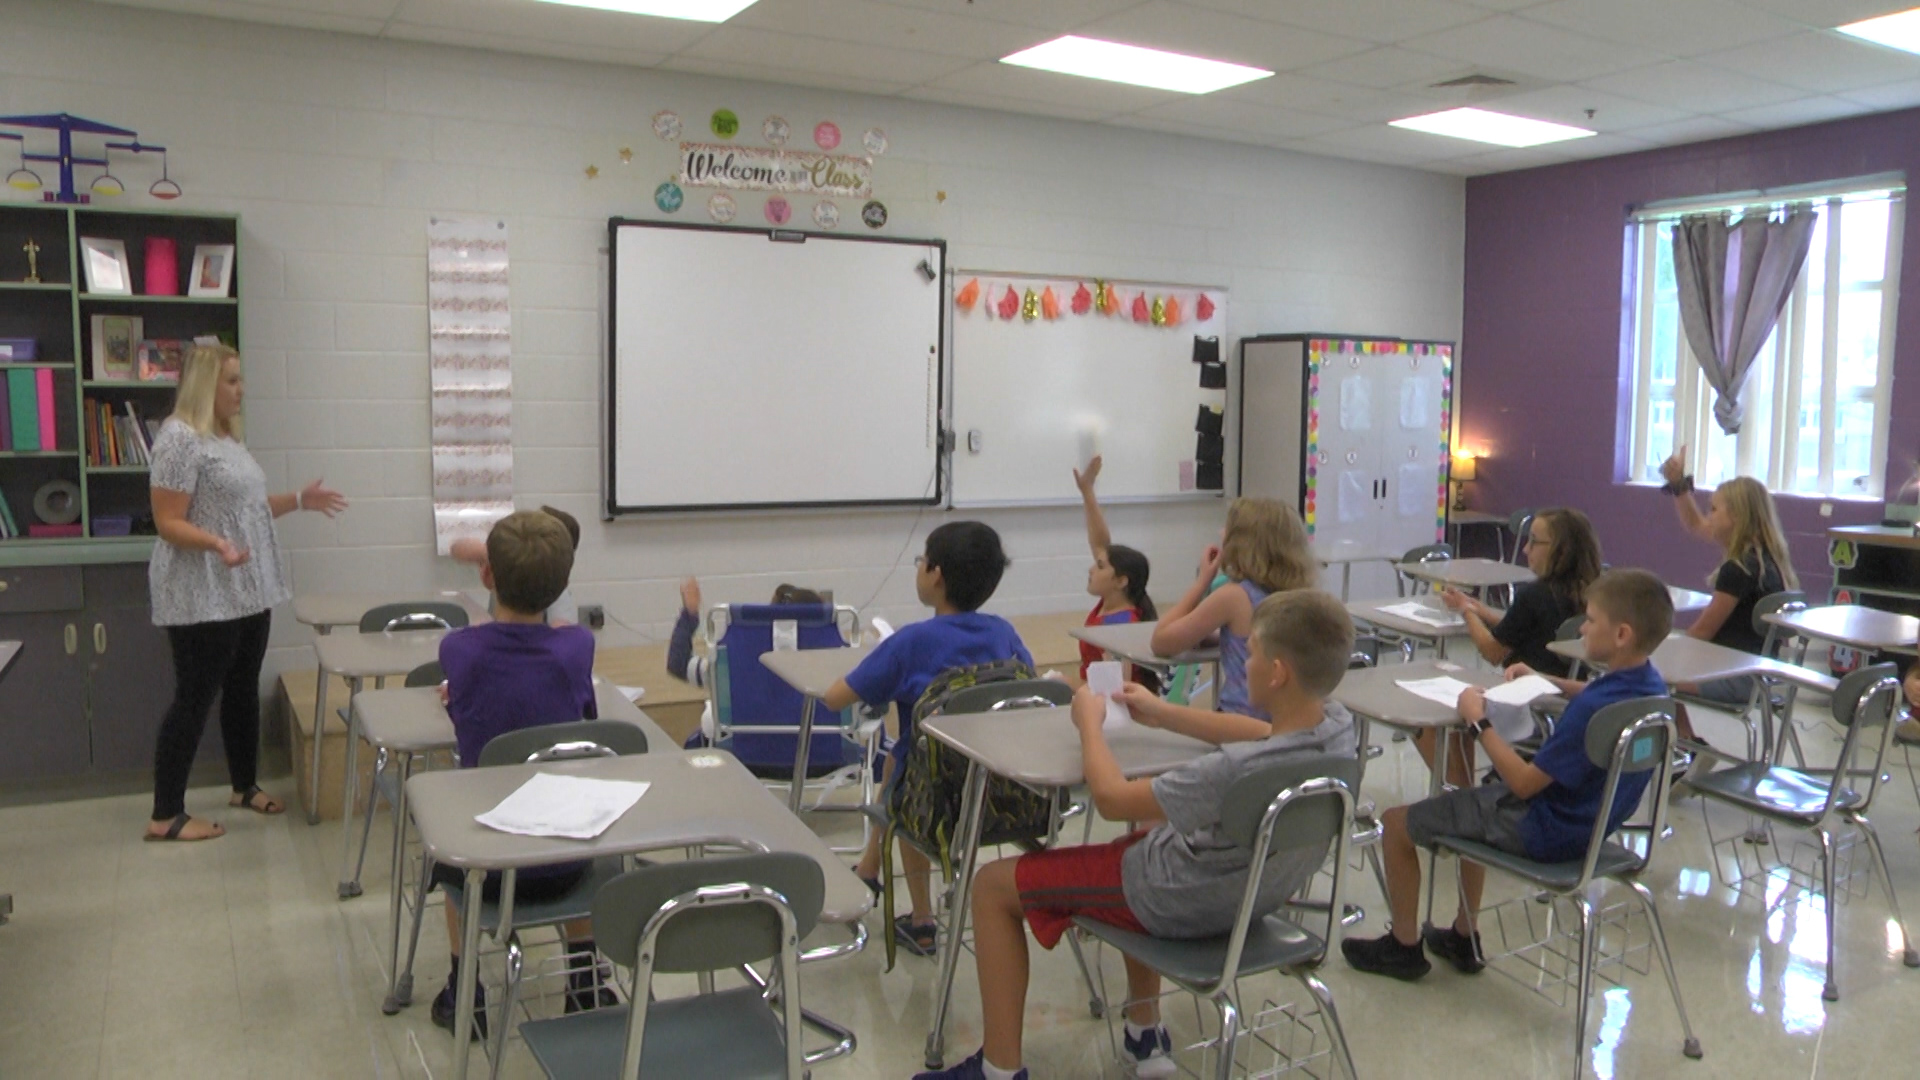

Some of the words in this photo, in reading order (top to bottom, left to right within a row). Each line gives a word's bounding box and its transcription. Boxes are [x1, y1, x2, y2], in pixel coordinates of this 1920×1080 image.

[686, 151, 786, 184] Welcome
[801, 155, 863, 189] Class
[1833, 540, 1852, 566] A
